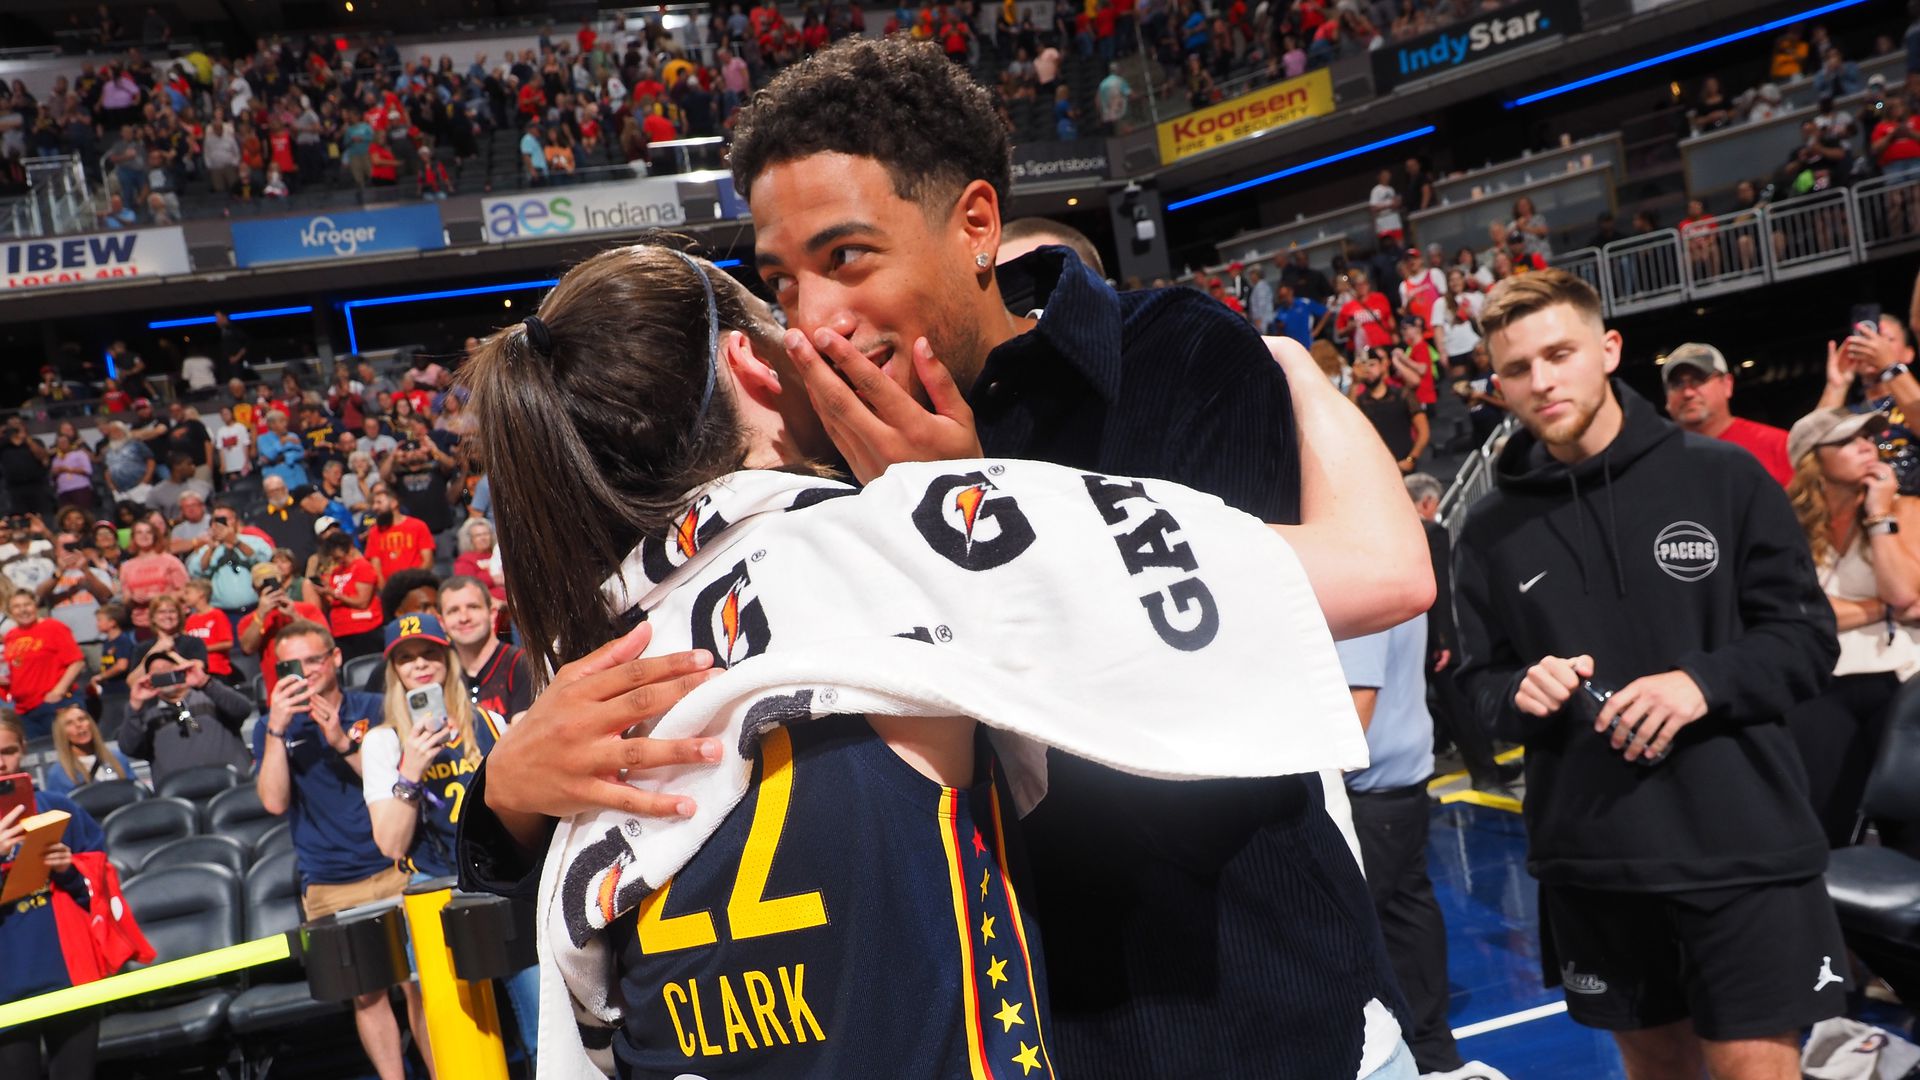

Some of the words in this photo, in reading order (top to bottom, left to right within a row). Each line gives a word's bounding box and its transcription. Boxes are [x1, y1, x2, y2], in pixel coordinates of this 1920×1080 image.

[1172, 88, 1308, 143] Koorsen
[1025, 157, 1105, 177] Sportsbook
[300, 216, 377, 257] Kroger
[490, 197, 576, 237] aes
[584, 202, 678, 229] Indiana
[7, 234, 138, 274] IBEW
[912, 470, 1037, 572] G
[1660, 541, 1714, 561] PACERS
[399, 616, 422, 637] 22
[662, 962, 827, 1058] CLARK
